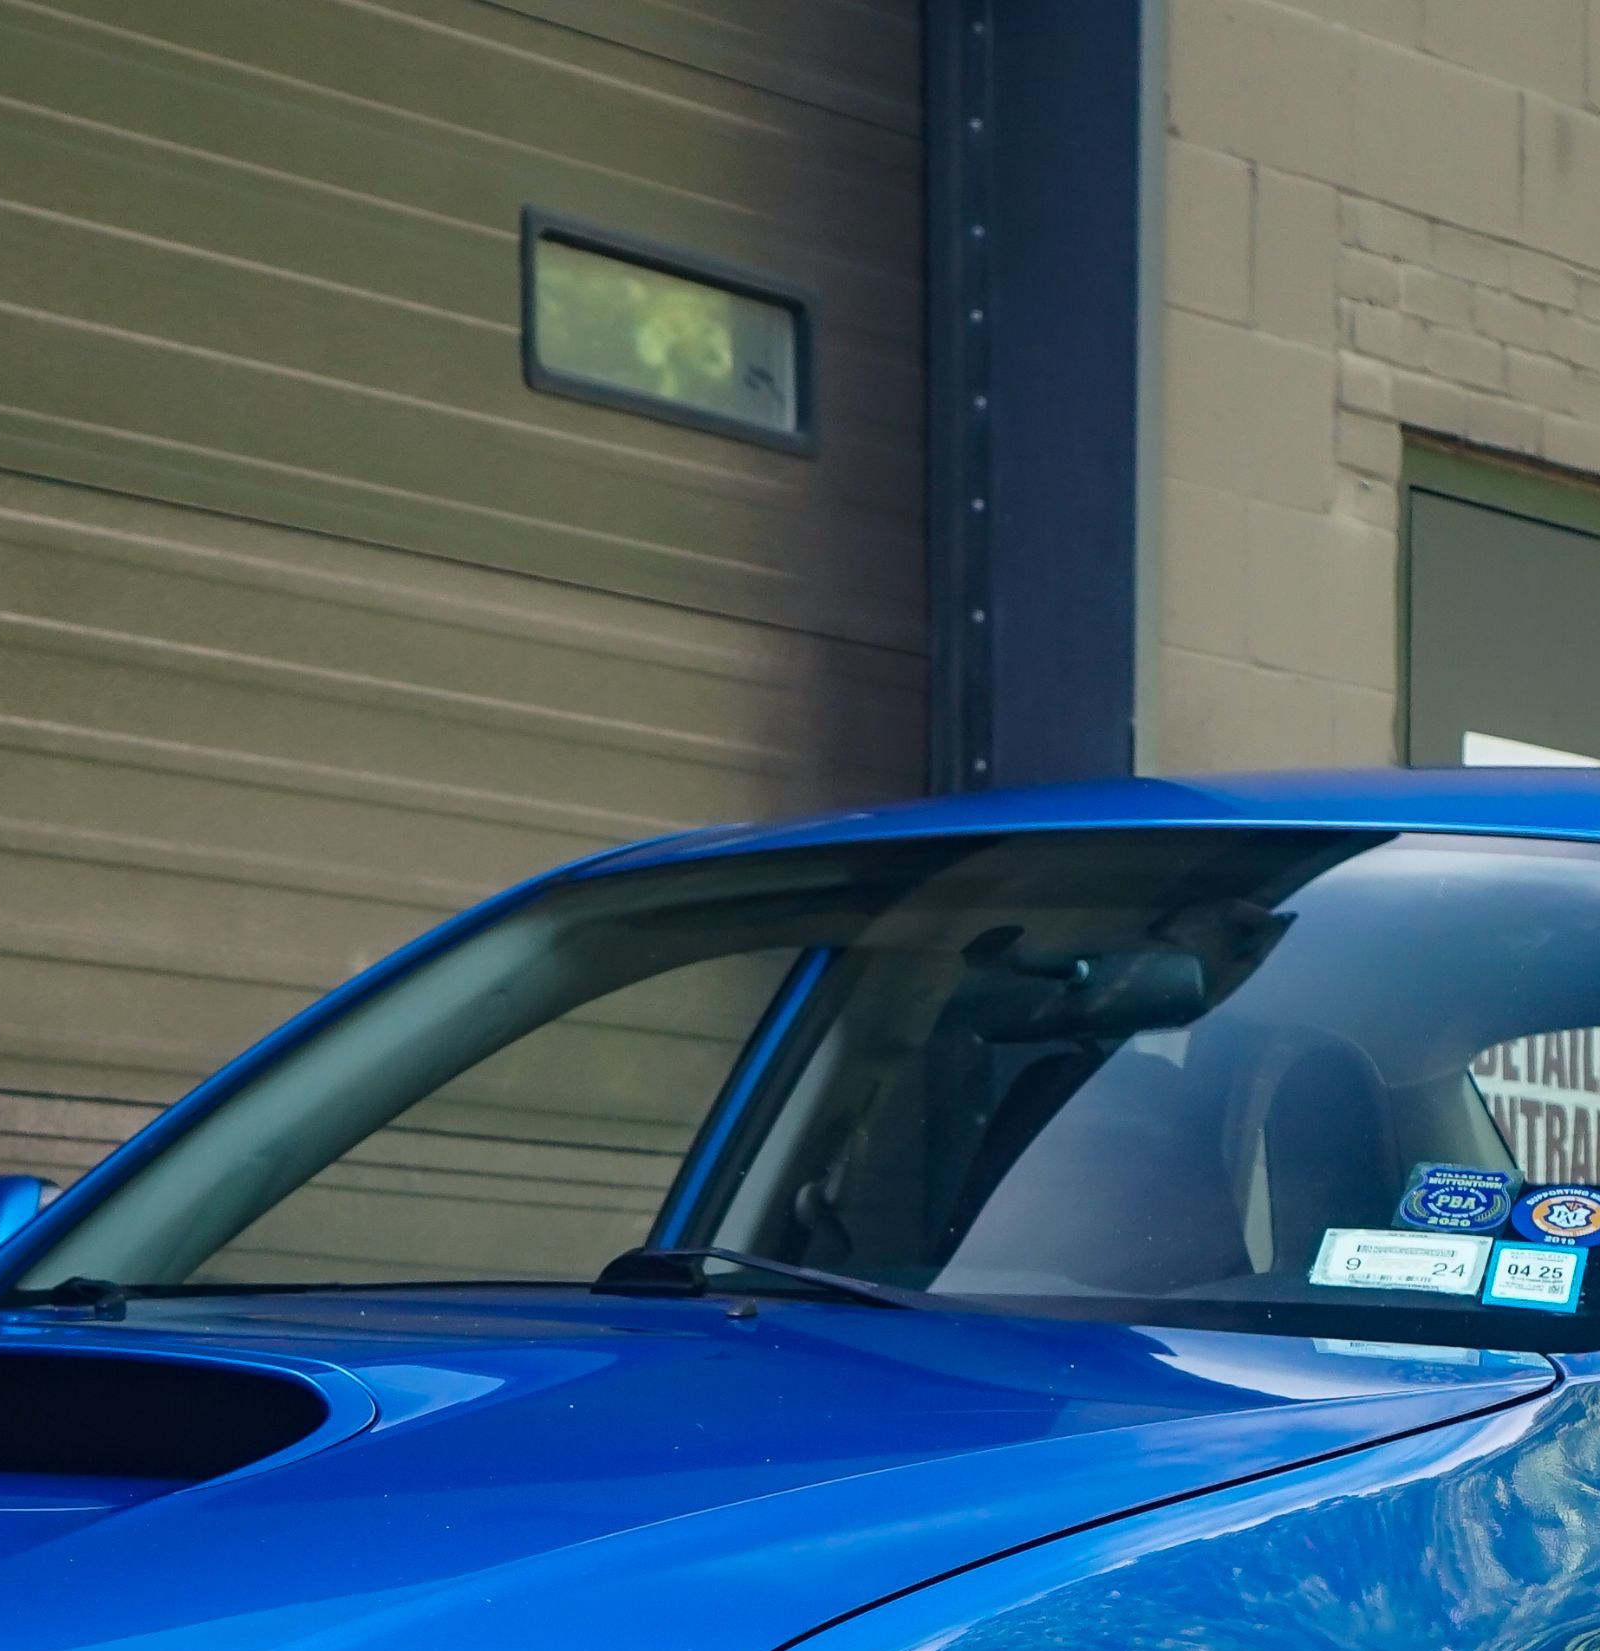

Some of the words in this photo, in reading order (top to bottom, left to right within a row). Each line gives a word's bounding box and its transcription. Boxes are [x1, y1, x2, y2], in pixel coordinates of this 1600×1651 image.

[1436, 1194, 1477, 1210] PBA
[1427, 1216, 1471, 1227] 2020
[1345, 1257, 1362, 1271] 9
[1431, 1262, 1466, 1278] 24
[1507, 1263, 1530, 1277] 04
[1538, 1265, 1564, 1279] 25
